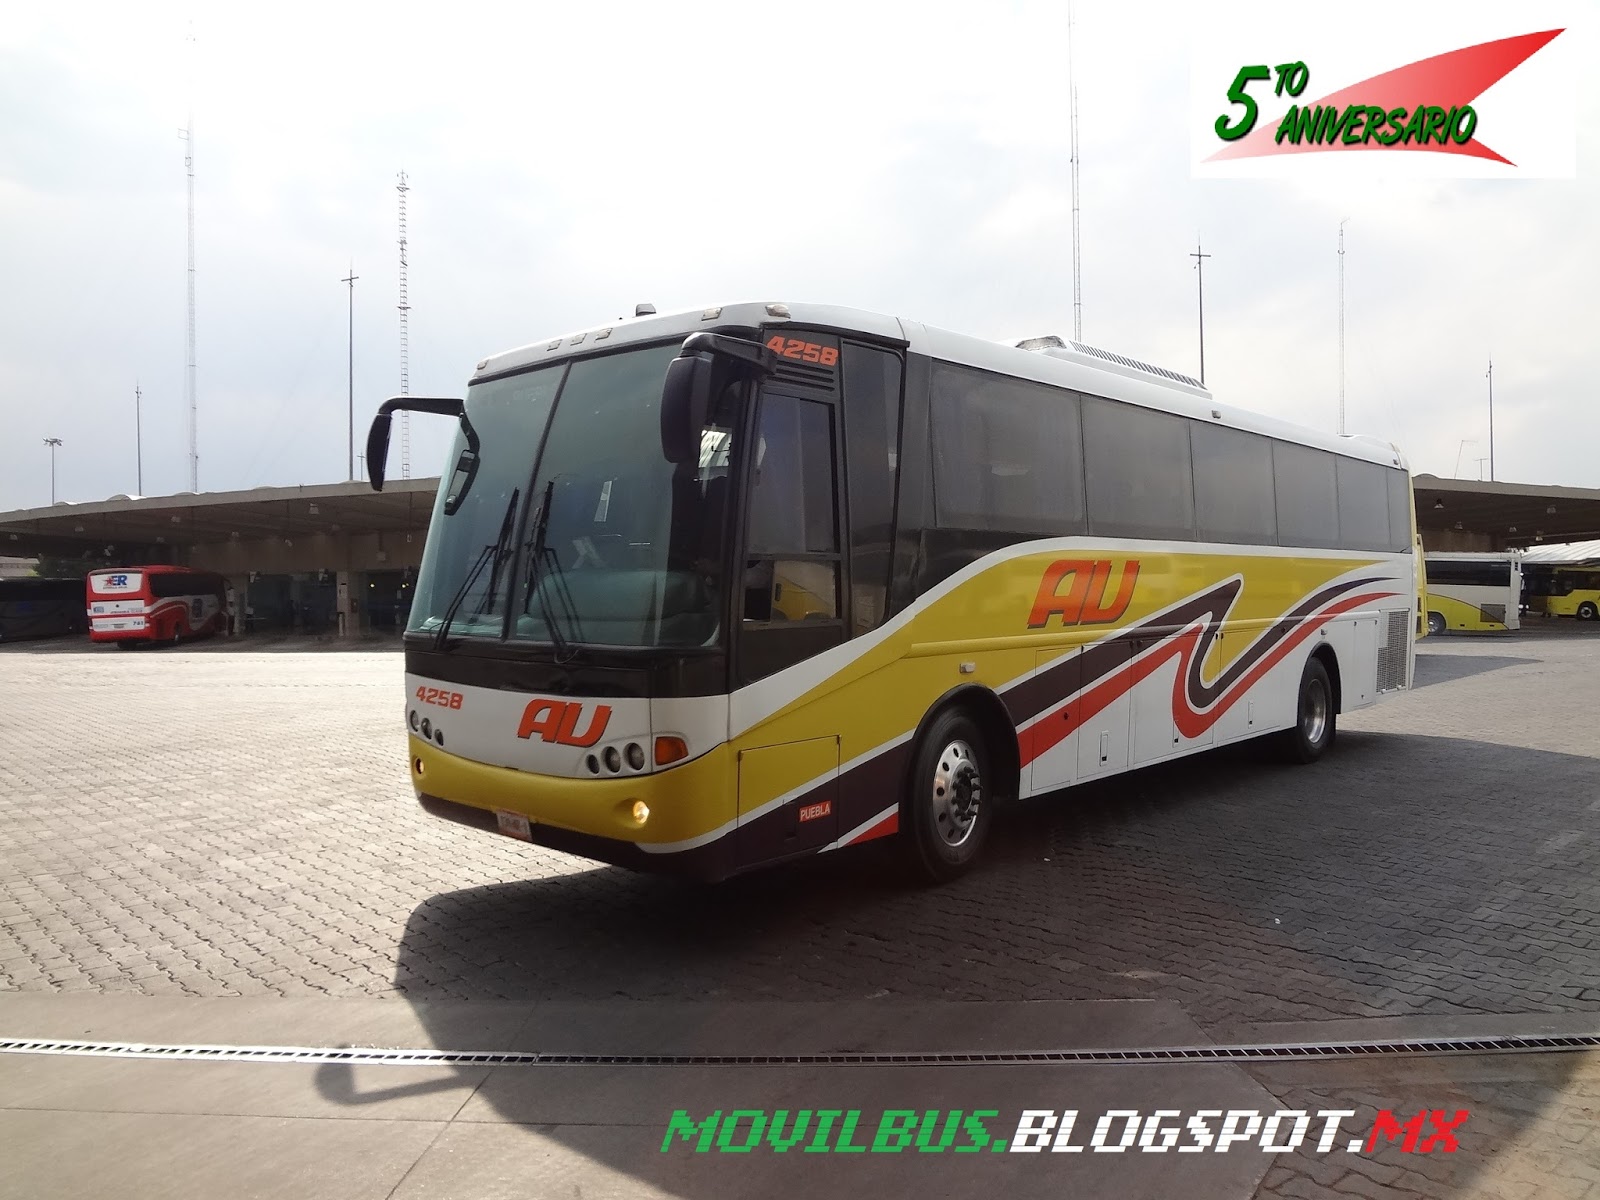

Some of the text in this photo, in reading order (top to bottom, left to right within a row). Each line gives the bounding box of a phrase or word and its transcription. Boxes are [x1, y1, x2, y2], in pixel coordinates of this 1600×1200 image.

[767, 335, 839, 367] 4258
[1027, 559, 1140, 629] AU
[416, 686, 464, 710] 4258
[517, 698, 612, 748] AU
[800, 803, 831, 821] PUEBLA
